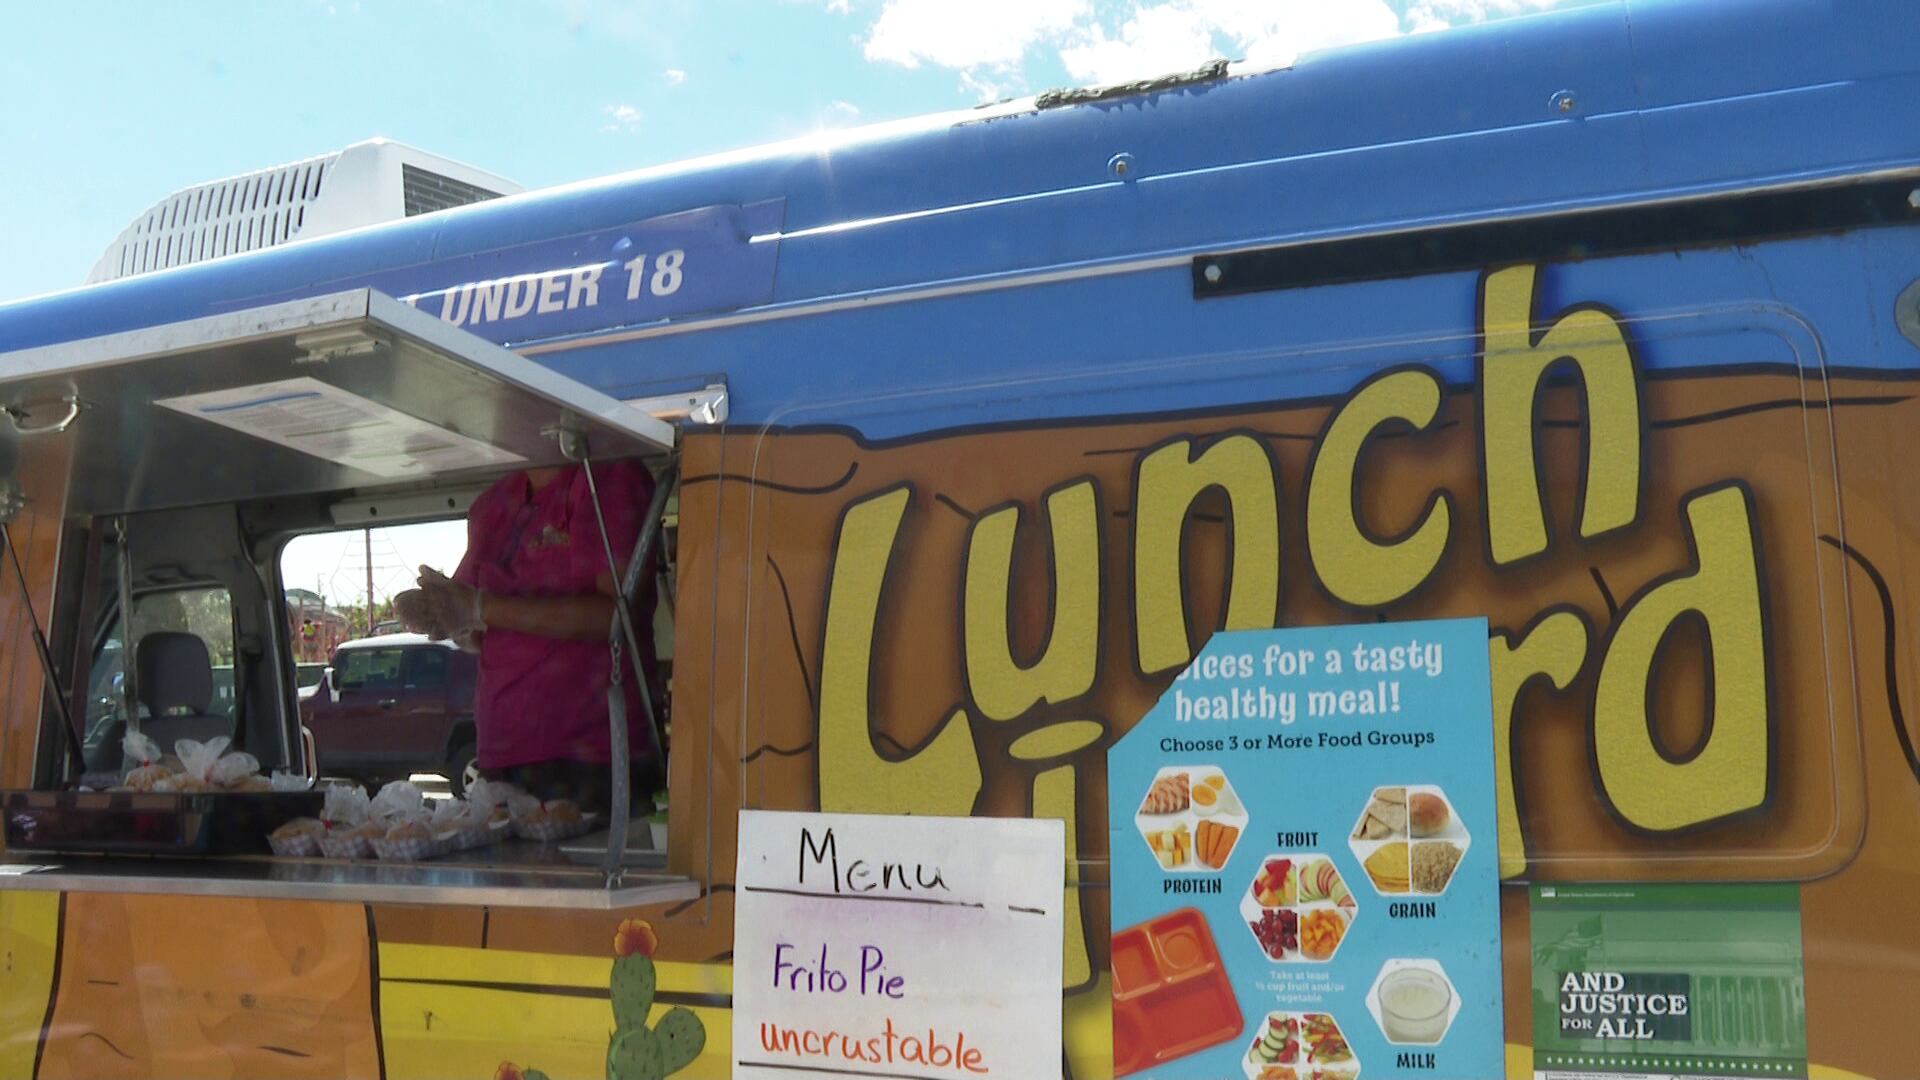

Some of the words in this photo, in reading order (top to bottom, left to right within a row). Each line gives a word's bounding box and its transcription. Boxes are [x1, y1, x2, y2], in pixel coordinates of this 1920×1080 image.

[439, 261, 604, 328] UNDER
[624, 249, 685, 300] 18
[818, 265, 1641, 815] Lunch
[1262, 644, 1315, 677] for
[1325, 649, 1342, 675] a
[1353, 639, 1443, 677] tasty
[1174, 685, 1296, 725] healthy
[1308, 681, 1401, 717] meal!
[1160, 737, 1224, 753] Choose
[1229, 735, 1239, 751] 3
[1243, 737, 1262, 751] or
[1267, 734, 1312, 750] More
[1318, 731, 1362, 747] Food
[1367, 730, 1436, 748] Groups
[1277, 831, 1319, 848] FRUIT
[799, 827, 951, 893] Menu
[1163, 878, 1223, 894] PROTEIN
[1389, 901, 1437, 919] GRAIN
[773, 943, 847, 993] Frito
[860, 945, 905, 999] Pie
[1560, 971, 1625, 993] AND
[1560, 993, 1689, 1016] JUSTICE
[1561, 1018, 1593, 1031] FOR
[1595, 1017, 1655, 1040] ALL
[760, 1017, 989, 1074] uncrustable
[1396, 1052, 1436, 1070] MILK
